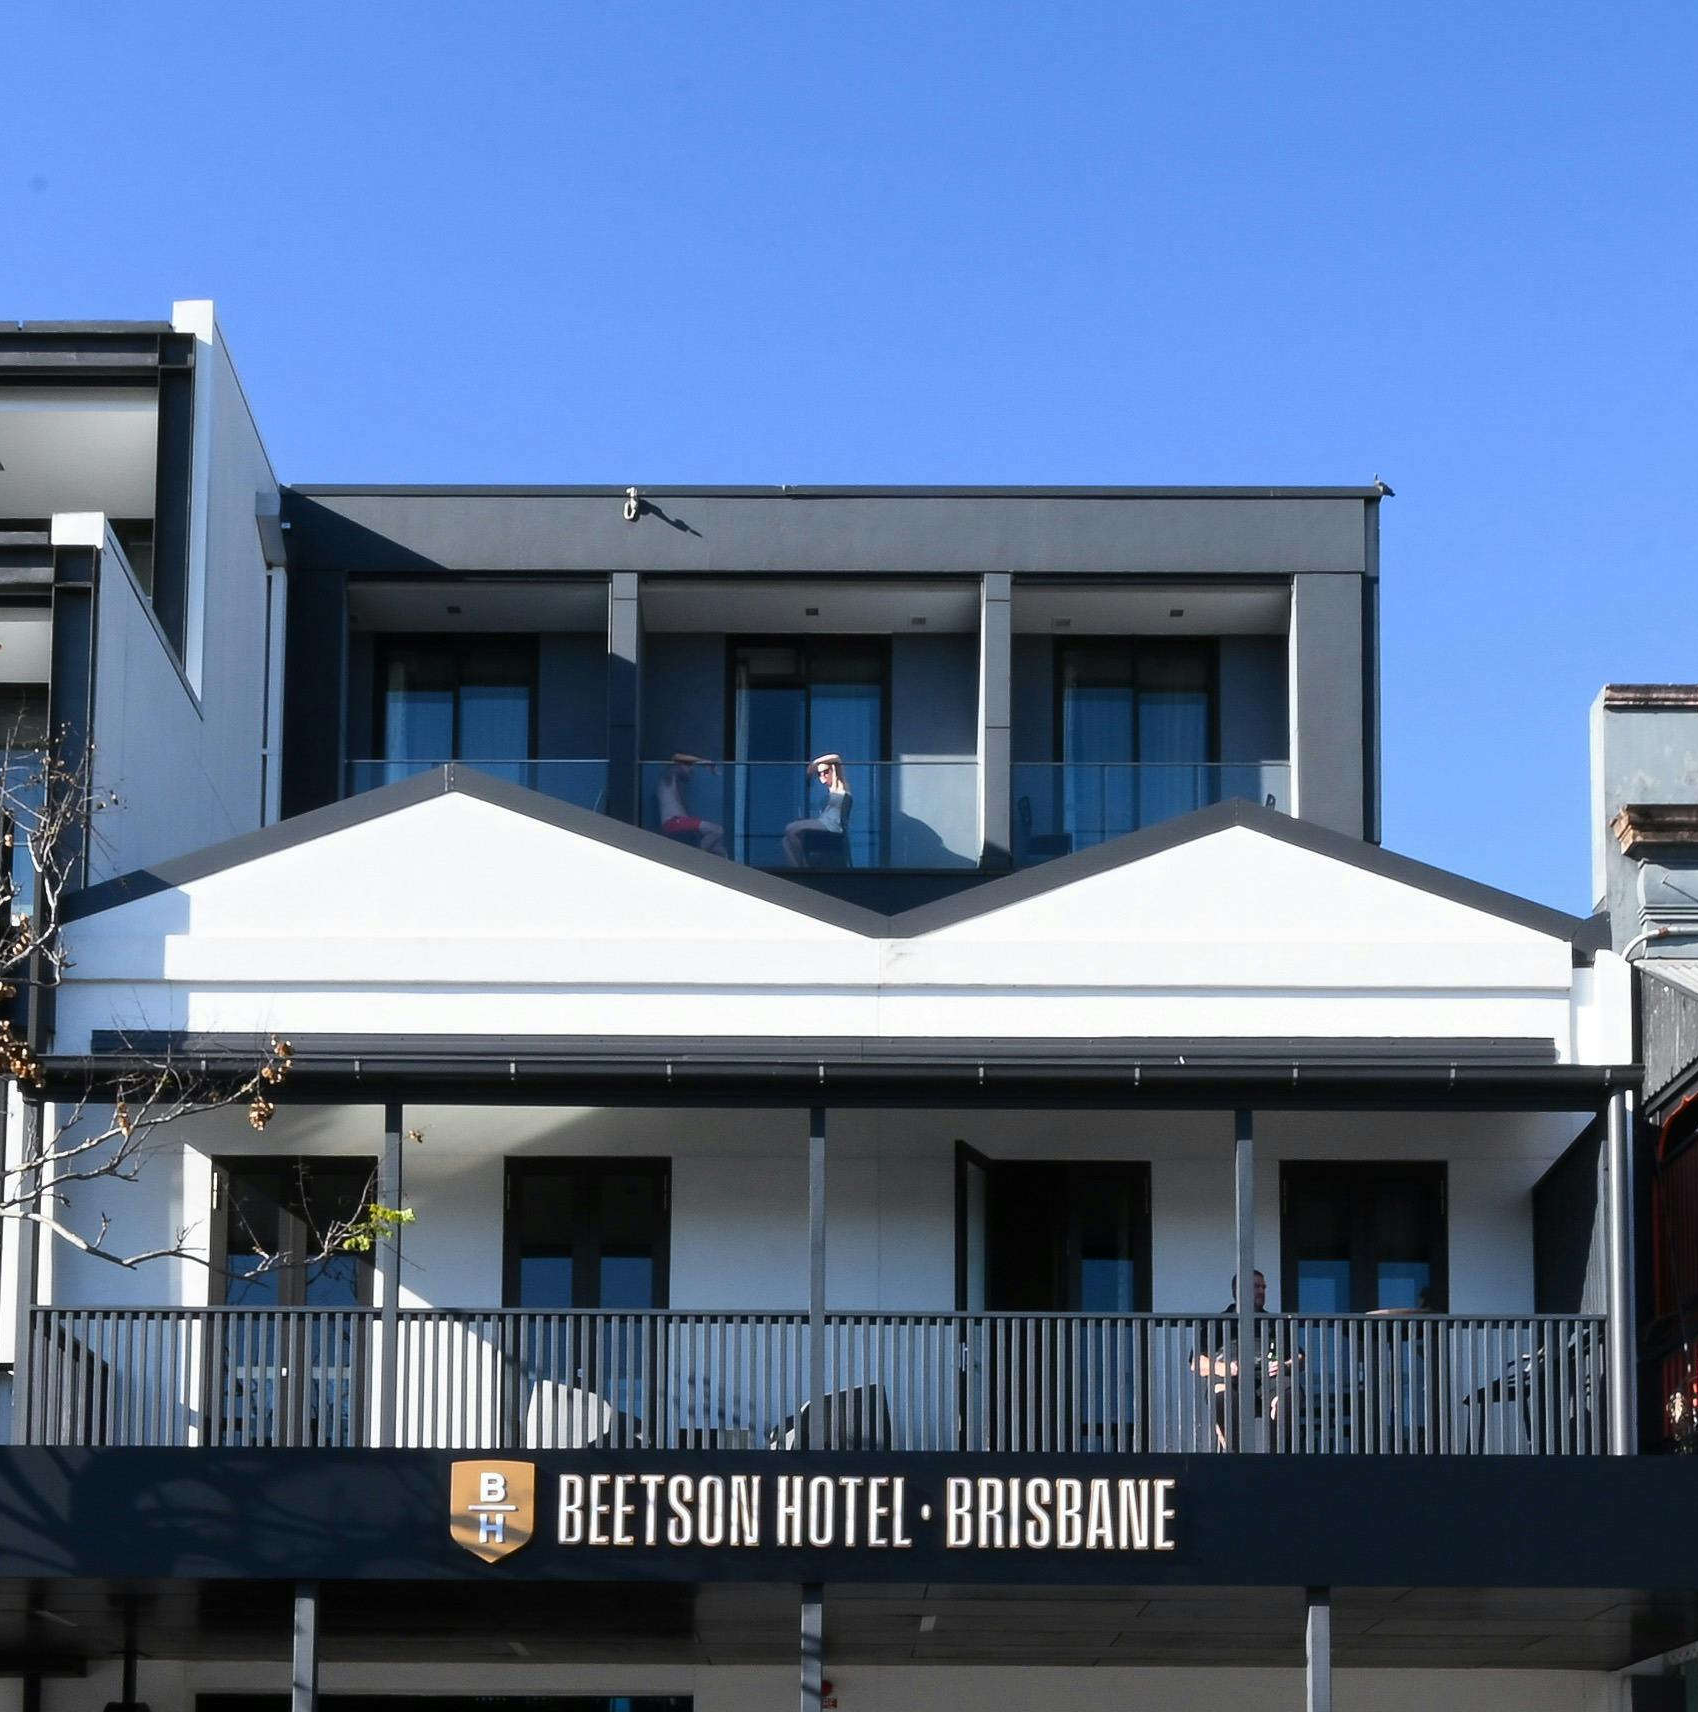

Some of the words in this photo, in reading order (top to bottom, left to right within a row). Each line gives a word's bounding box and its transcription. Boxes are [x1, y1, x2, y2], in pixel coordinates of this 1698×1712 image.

[480, 1472, 506, 1502] B
[558, 1474, 761, 1546] BEETSON
[777, 1475, 912, 1547] HOTEL
[946, 1476, 1176, 1550] BRISBANE
[479, 1513, 505, 1543] H
